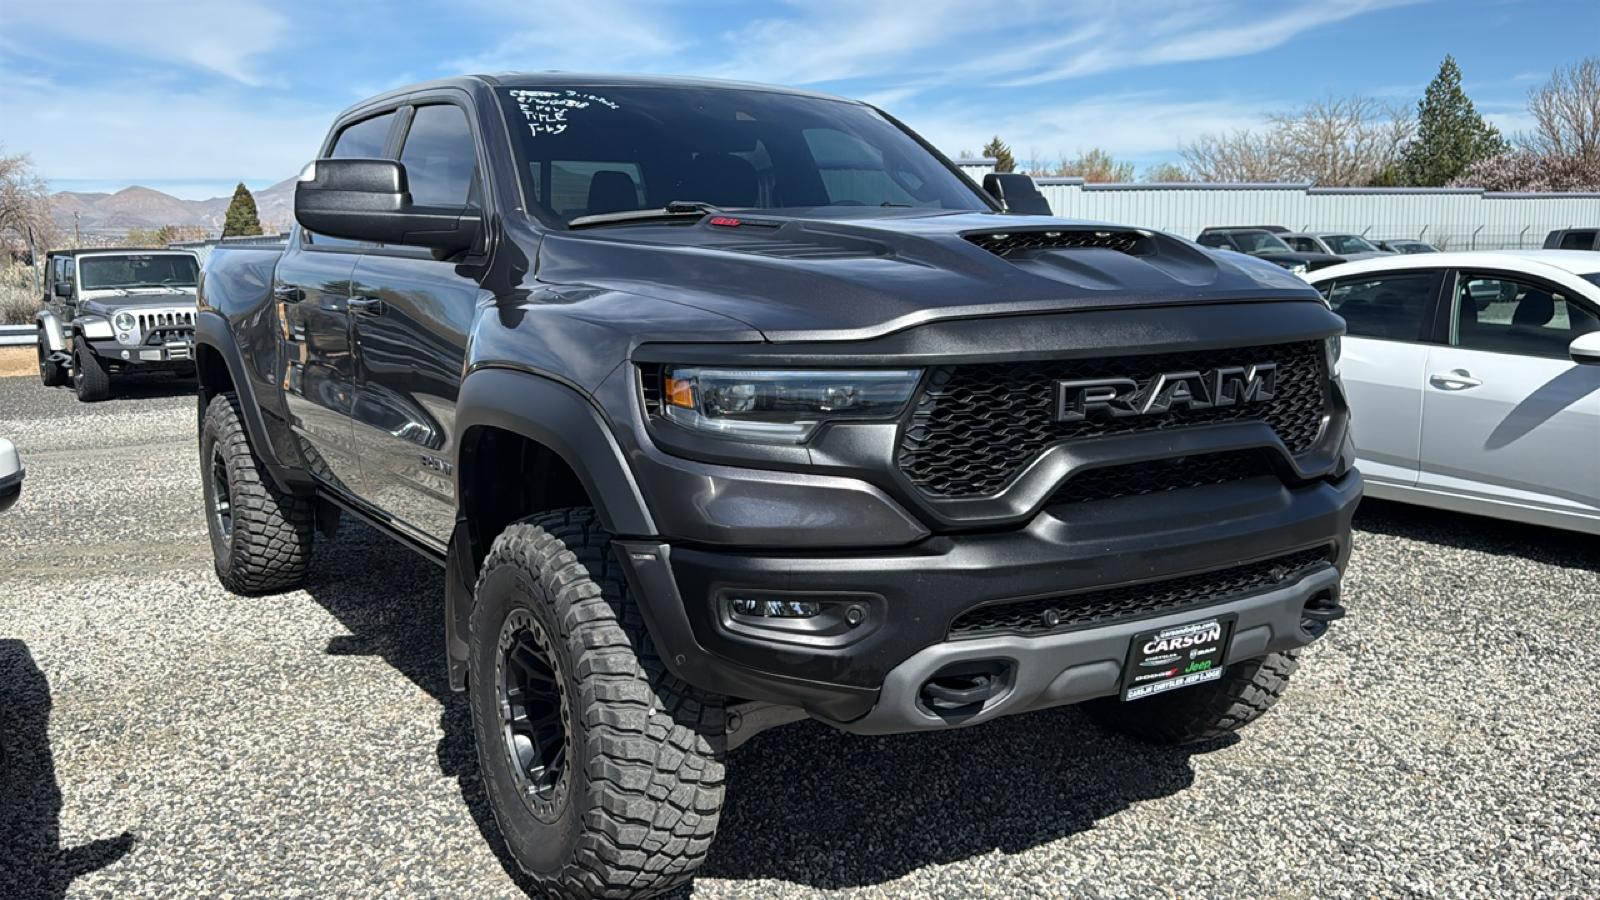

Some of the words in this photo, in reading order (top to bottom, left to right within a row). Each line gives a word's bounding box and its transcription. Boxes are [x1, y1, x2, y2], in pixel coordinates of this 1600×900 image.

[1050, 363, 1277, 422] RAM
[1143, 624, 1221, 654] CARSON
[1184, 659, 1212, 673] Jeep
